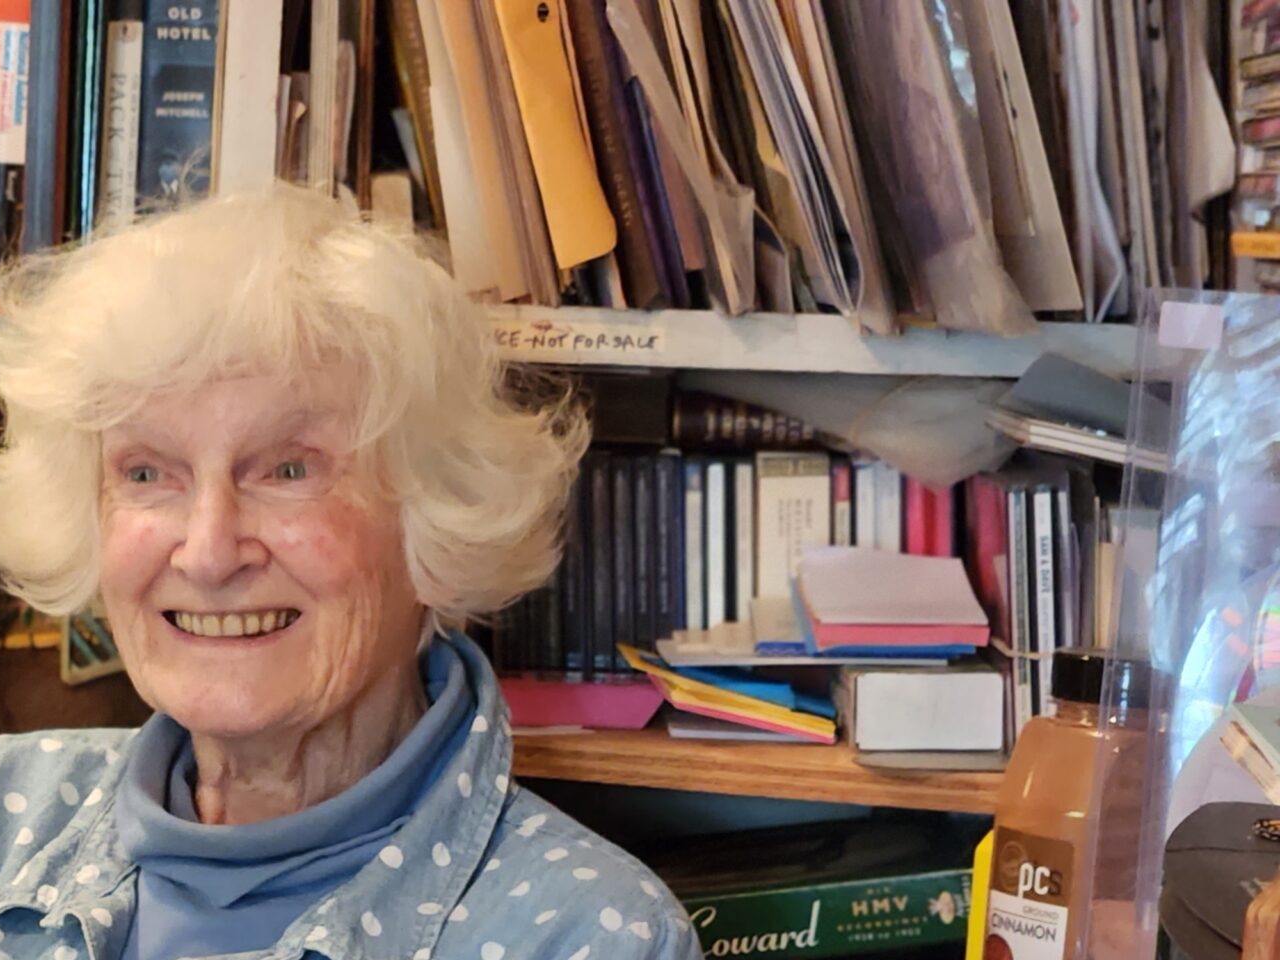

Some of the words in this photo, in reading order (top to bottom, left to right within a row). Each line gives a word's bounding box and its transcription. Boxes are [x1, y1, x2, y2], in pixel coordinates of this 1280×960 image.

[167, 7, 202, 21] OLD
[156, 27, 212, 41] HOTEL
[162, 90, 205, 103] JOSEPH
[156, 106, 209, 119] MITCHELL
[573, 334, 608, 350] FOR
[612, 335, 659, 350] SALE
[851, 895, 908, 917] HMV
[991, 912, 1057, 942] CINNAMON
